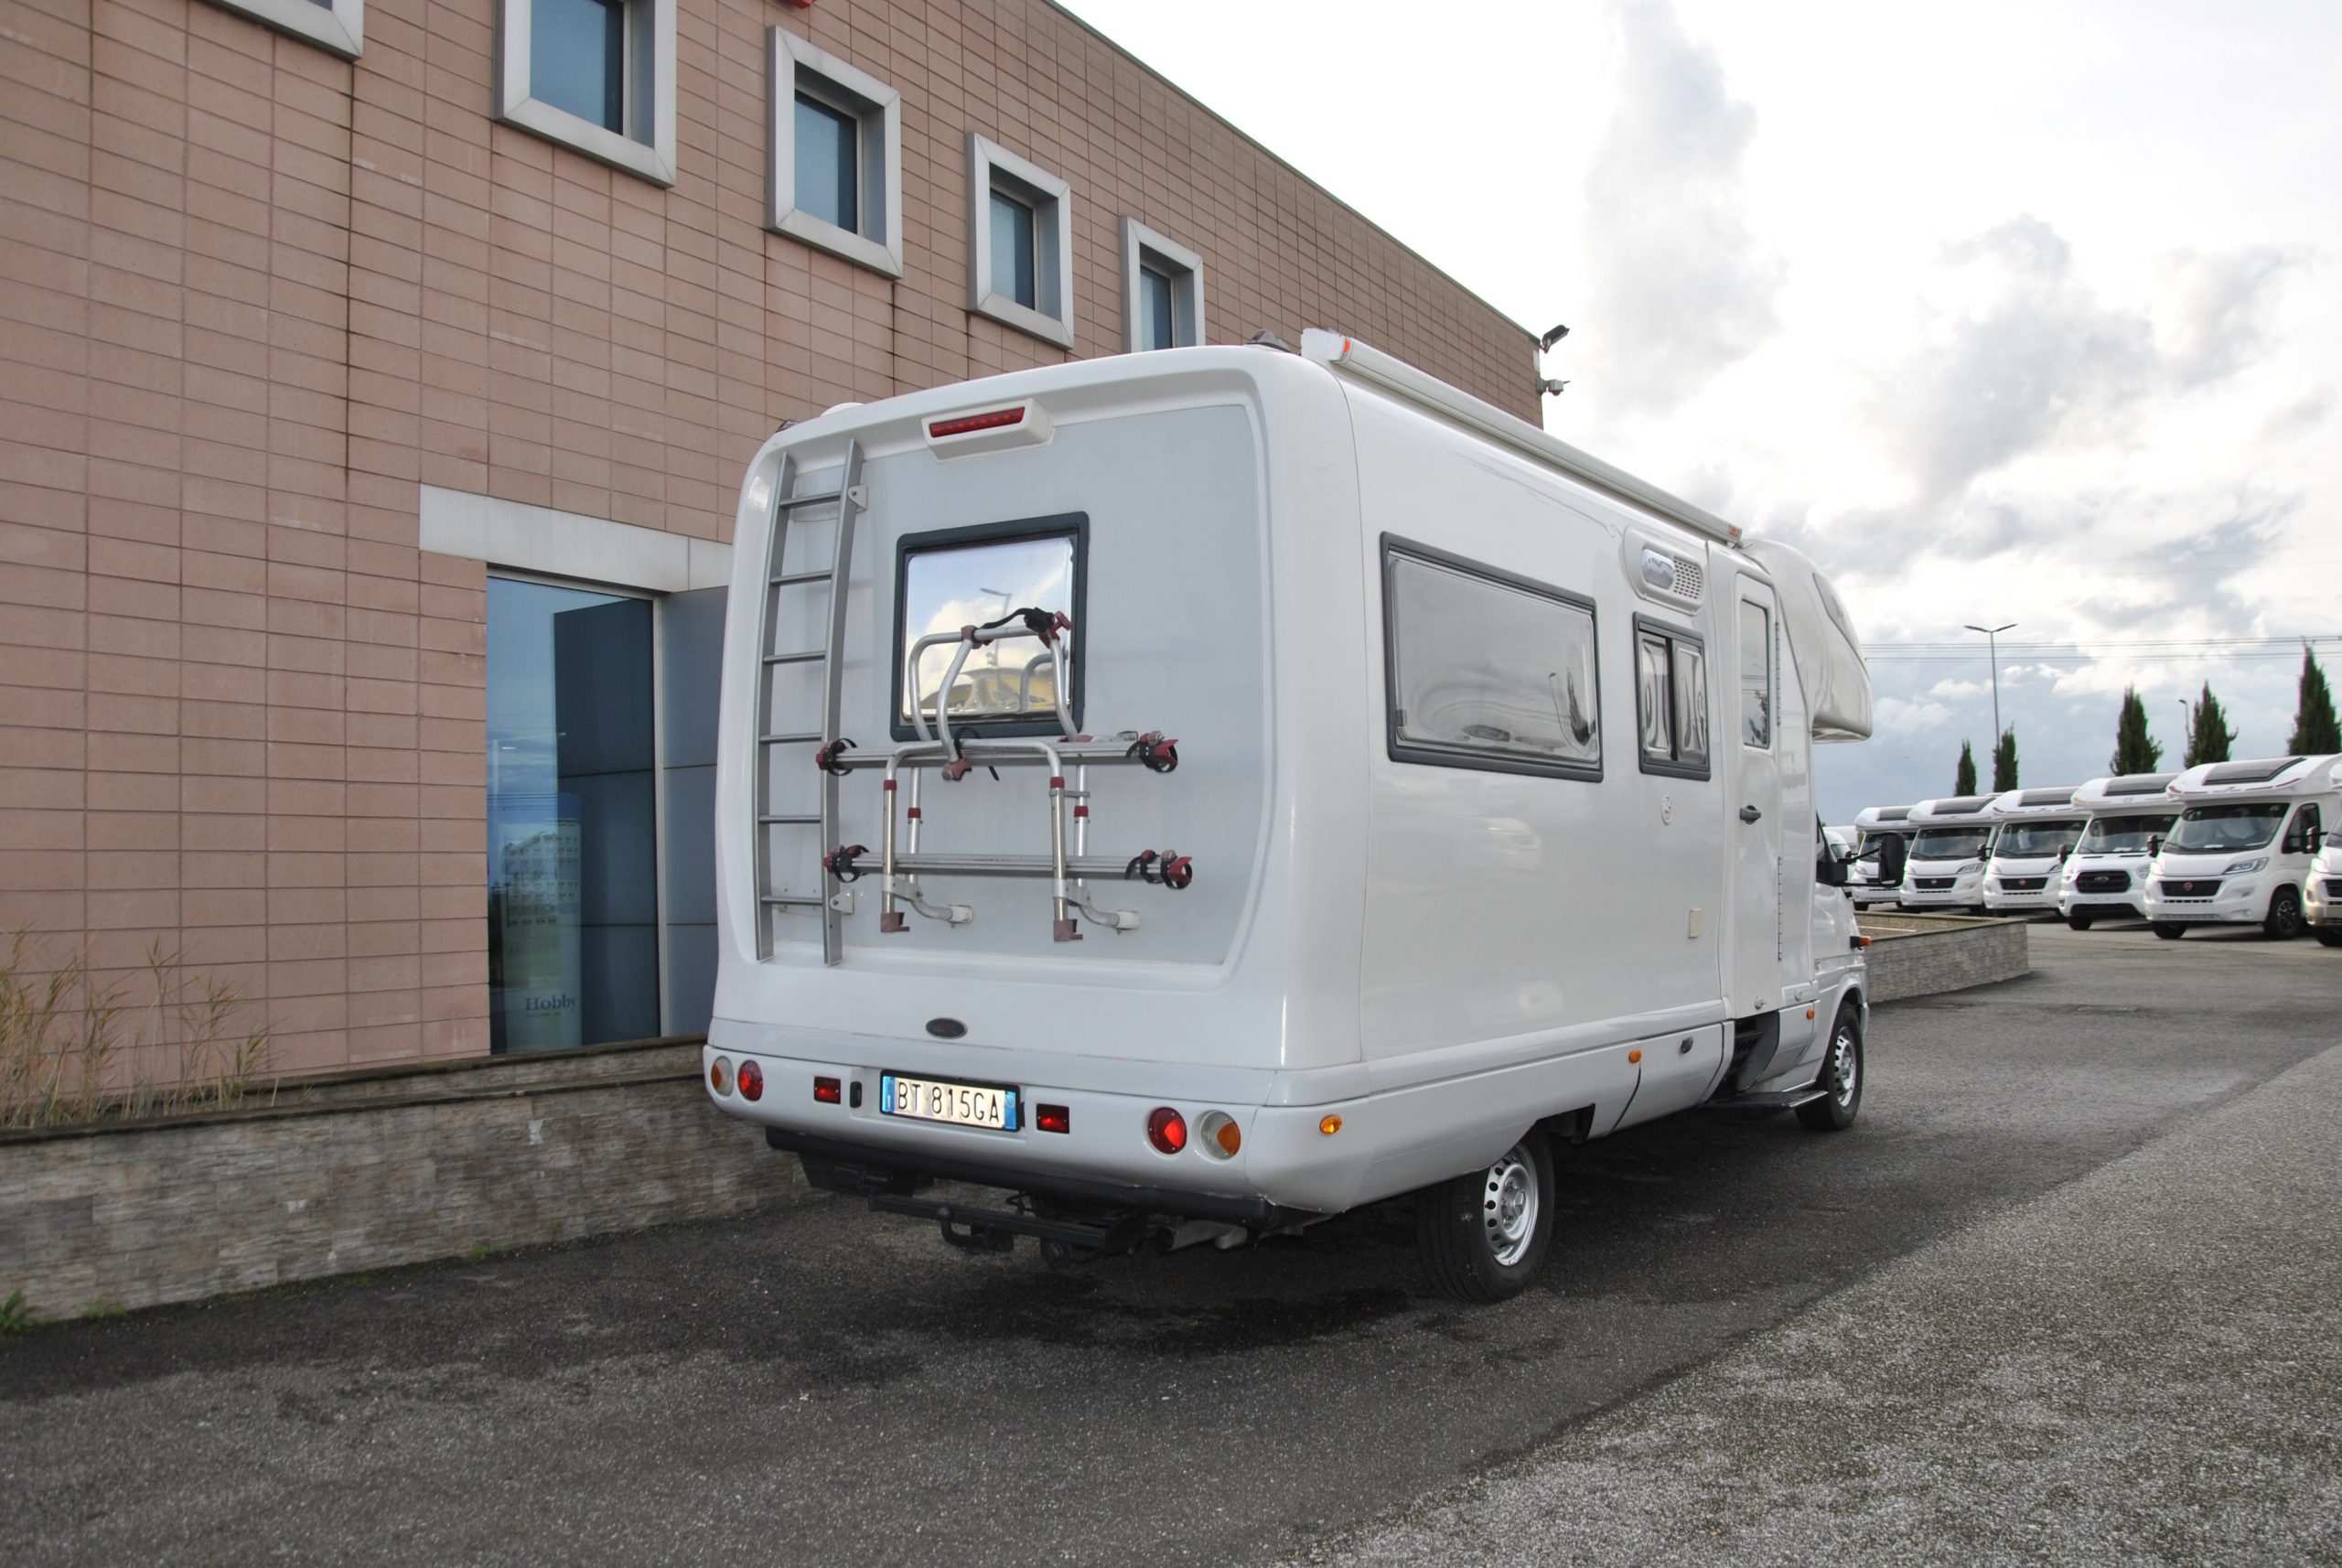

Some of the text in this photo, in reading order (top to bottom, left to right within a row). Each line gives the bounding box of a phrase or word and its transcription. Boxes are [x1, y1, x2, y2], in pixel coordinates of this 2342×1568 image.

[525, 993, 575, 1012] Hobby
[898, 1081, 921, 1111] BT
[931, 1086, 999, 1123] 815GA
